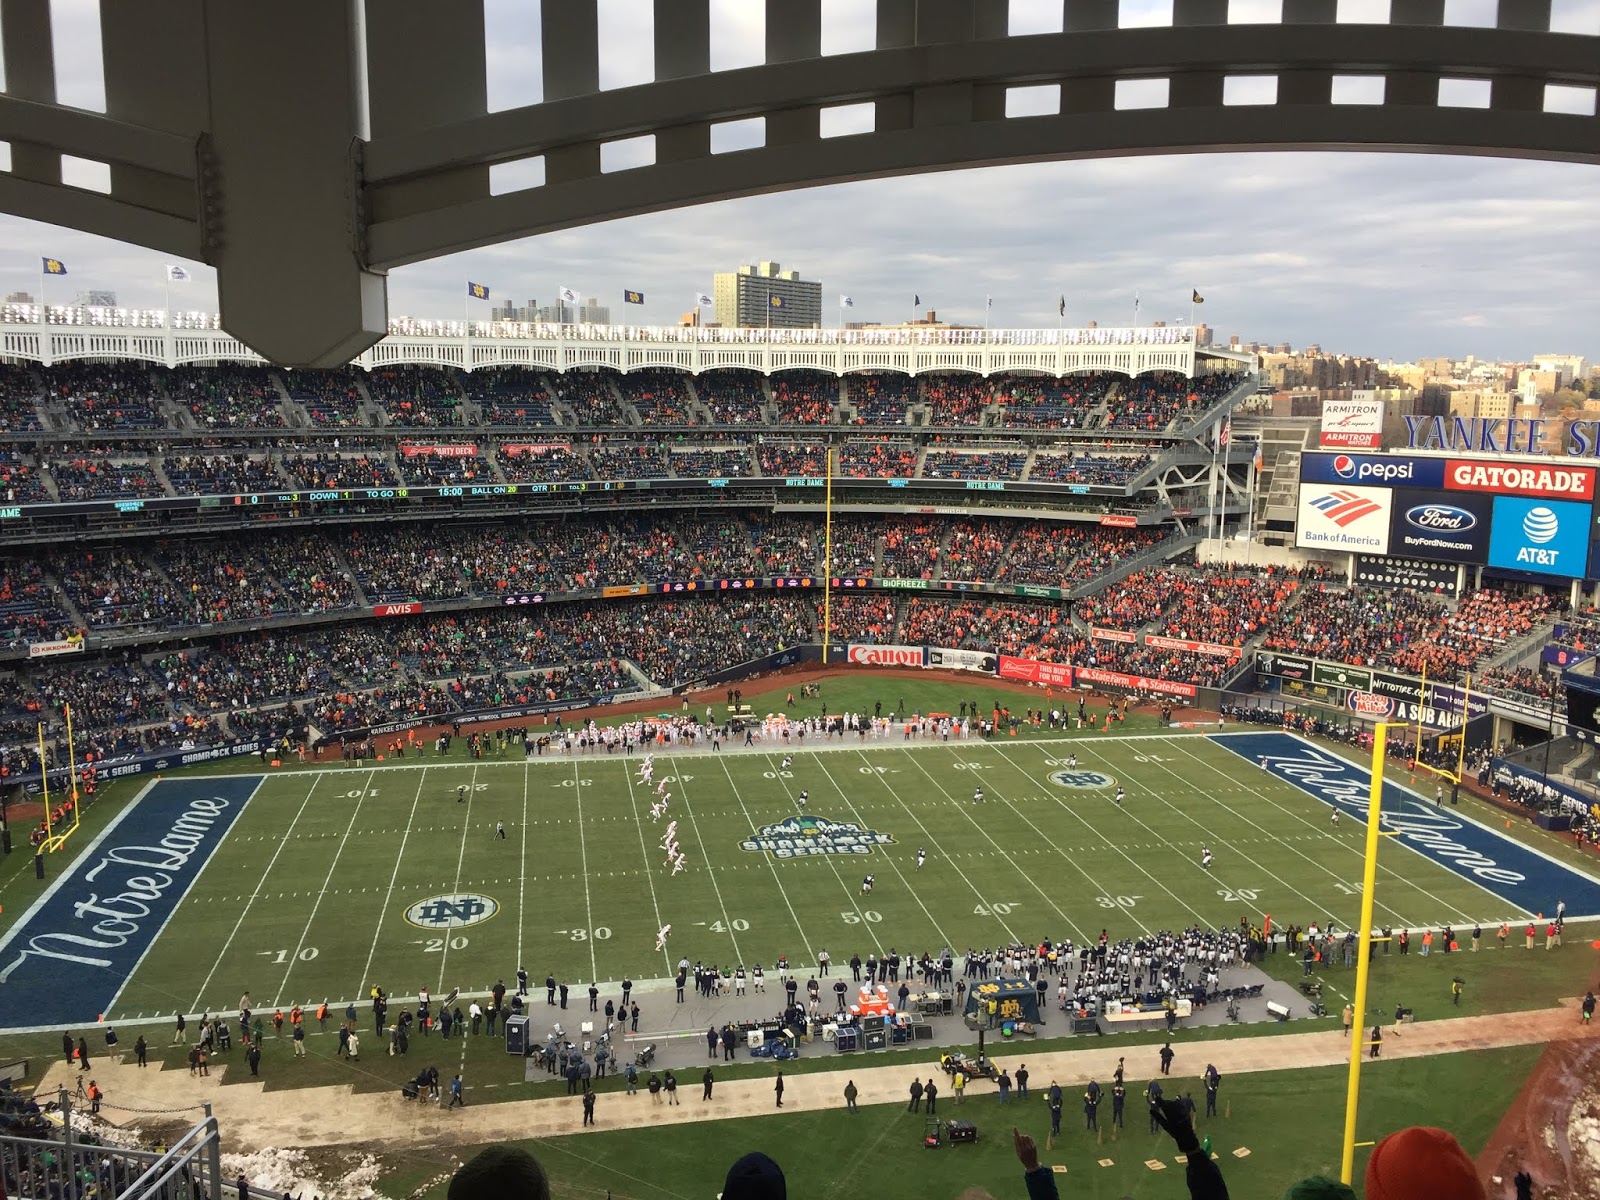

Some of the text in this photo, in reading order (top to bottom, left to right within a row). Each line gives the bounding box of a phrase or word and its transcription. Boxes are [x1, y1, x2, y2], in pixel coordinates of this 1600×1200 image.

[1325, 405, 1378, 414] ARMITRON
[1326, 433, 1373, 442] ARMITRON
[1401, 414, 1548, 455] YANKEE
[455, 446, 473, 455] DECK
[1359, 462, 1413, 481] pepsi
[786, 478, 824, 486] NOTRE DAME
[966, 481, 1004, 490] NOTRE DAME
[1454, 465, 1586, 493] GATORADE
[310, 492, 338, 500] DOWN
[367, 489, 408, 498] TO GO 10
[438, 487, 463, 496] 15:00
[472, 485, 516, 495] BALL ON 20
[0, 508, 21, 518] AME
[1419, 508, 1461, 529] Ford
[1101, 516, 1136, 527] Budweiser
[1305, 531, 1381, 546] Bank of America
[1404, 536, 1473, 551] BuyFordNow.com
[1516, 547, 1559, 565] AT&T
[385, 604, 412, 615] AVIS
[41, 643, 76, 652] KIKKOMAN
[849, 646, 922, 665] Canon
[1039, 664, 1071, 676] THIS BUD'S
[1277, 658, 1309, 670] Panasonic
[1039, 672, 1065, 683] FOR YOU.
[1354, 691, 1389, 705] Jersey
[1397, 702, 1406, 719] A
[1409, 704, 1435, 725] SUB
[370, 720, 422, 735] YANKEE STADIUM
[232, 742, 259, 755] SERIES
[111, 763, 141, 776] SERIES
[775, 845, 870, 859] SERIES
[0, 797, 230, 984] Notre Dame
[1216, 888, 1258, 902] 20
[1095, 895, 1138, 909] 30
[973, 902, 1013, 917] 40
[840, 910, 884, 925] 50
[708, 918, 750, 933] 40
[570, 926, 613, 942] 30
[423, 936, 469, 953] 20
[271, 947, 319, 964] 10
